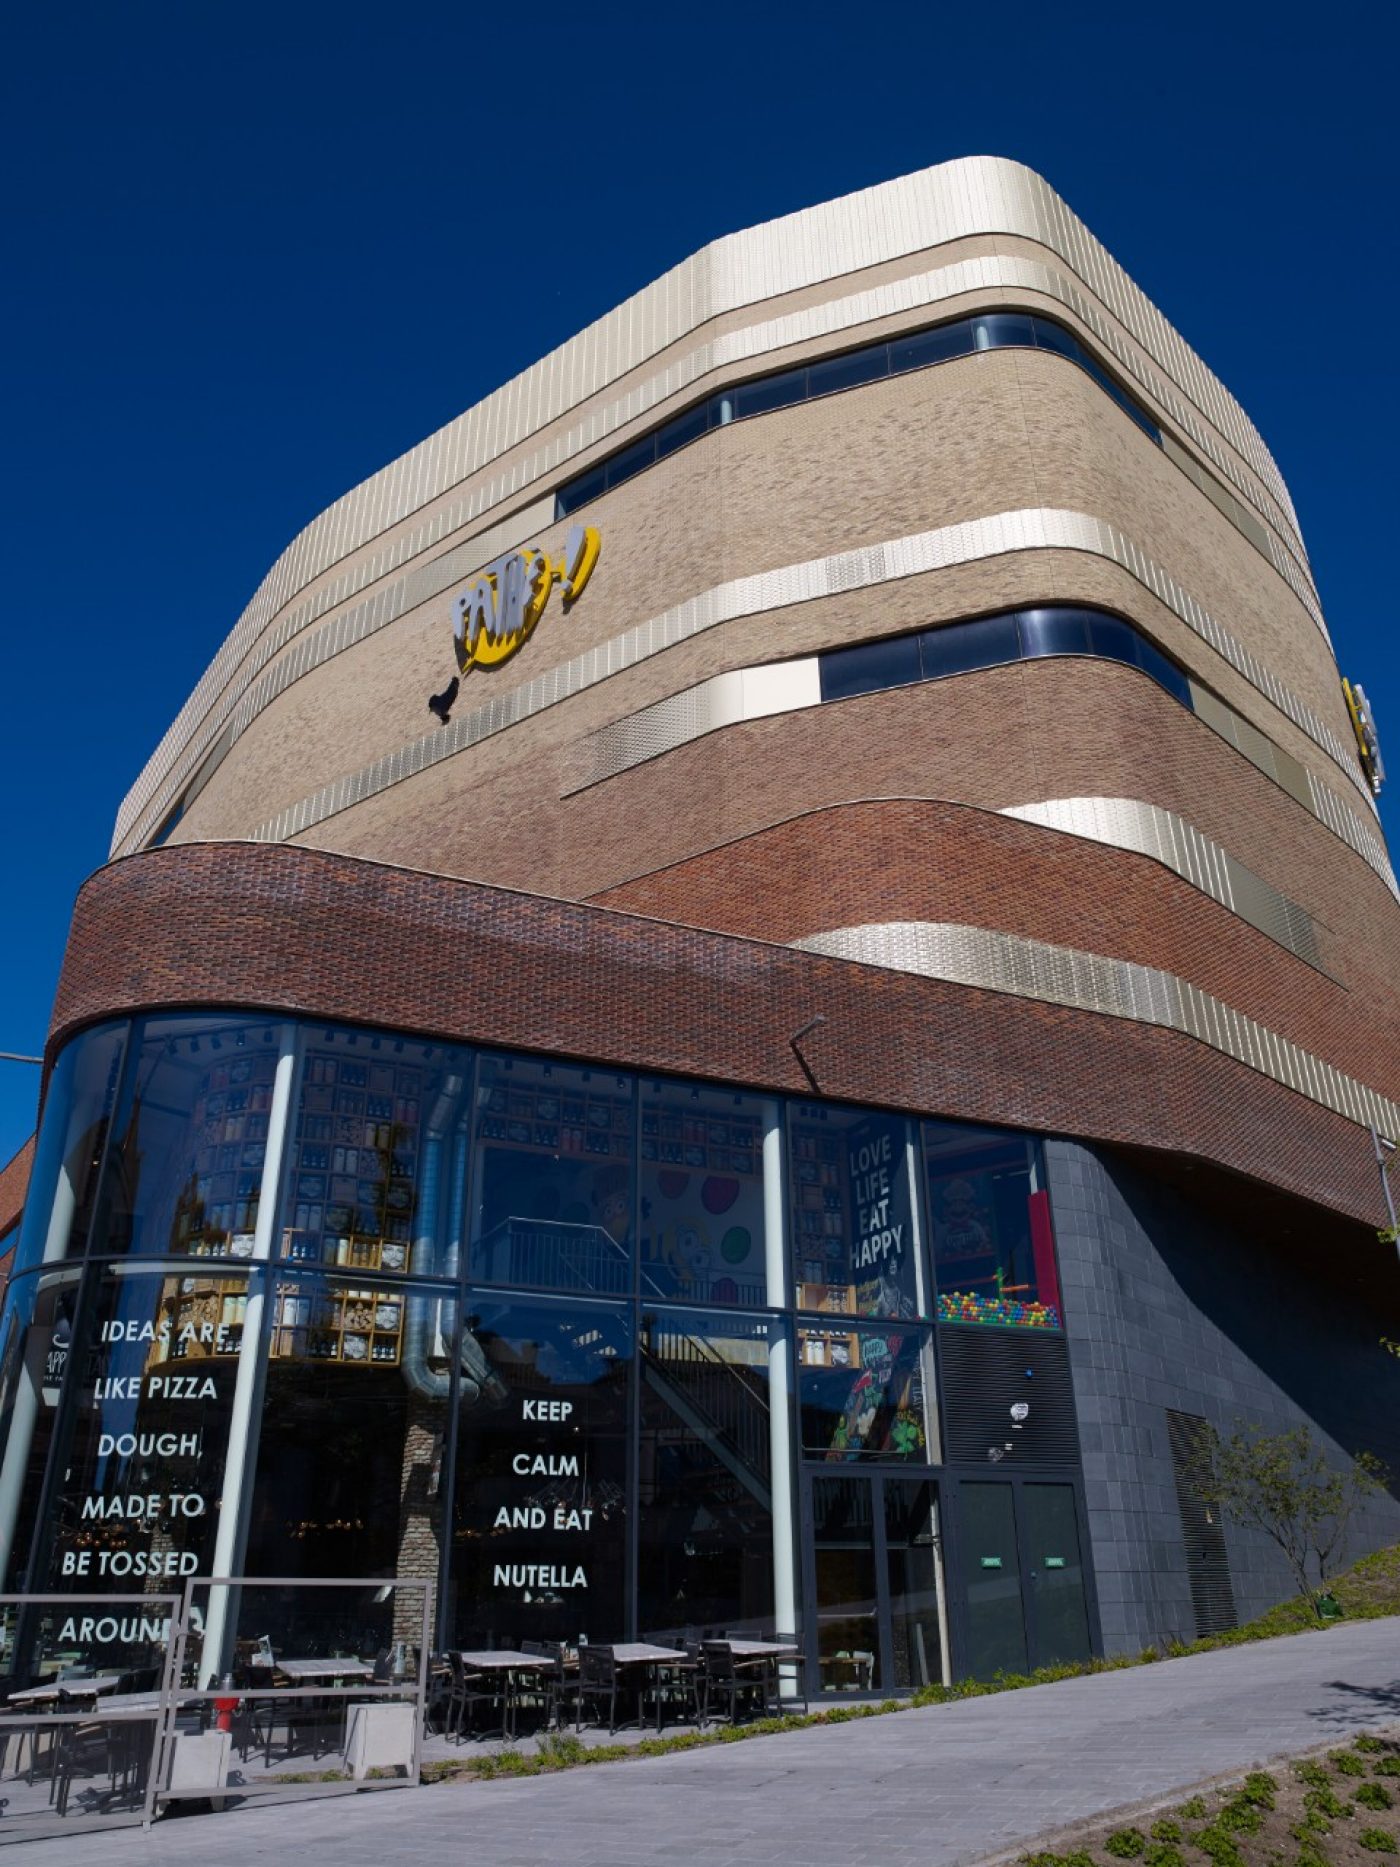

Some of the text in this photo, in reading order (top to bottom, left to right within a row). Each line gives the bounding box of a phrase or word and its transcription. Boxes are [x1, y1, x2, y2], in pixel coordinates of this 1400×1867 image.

[850, 1134, 892, 1177] LOVE
[856, 1166, 889, 1205] LIFE
[860, 1198, 889, 1235] EAT
[849, 1224, 902, 1271] HAPPY
[101, 1320, 230, 1344] IDEAS ARE
[94, 1376, 218, 1400] LIKE PIZZA
[522, 1399, 573, 1421] KEEP
[98, 1433, 204, 1458] DOUGH,
[512, 1453, 579, 1477] CALM
[81, 1494, 205, 1520] MADE TO
[493, 1506, 593, 1531] AND EAT
[61, 1551, 199, 1577] BE TOSSED
[493, 1564, 588, 1588] NUTELLA
